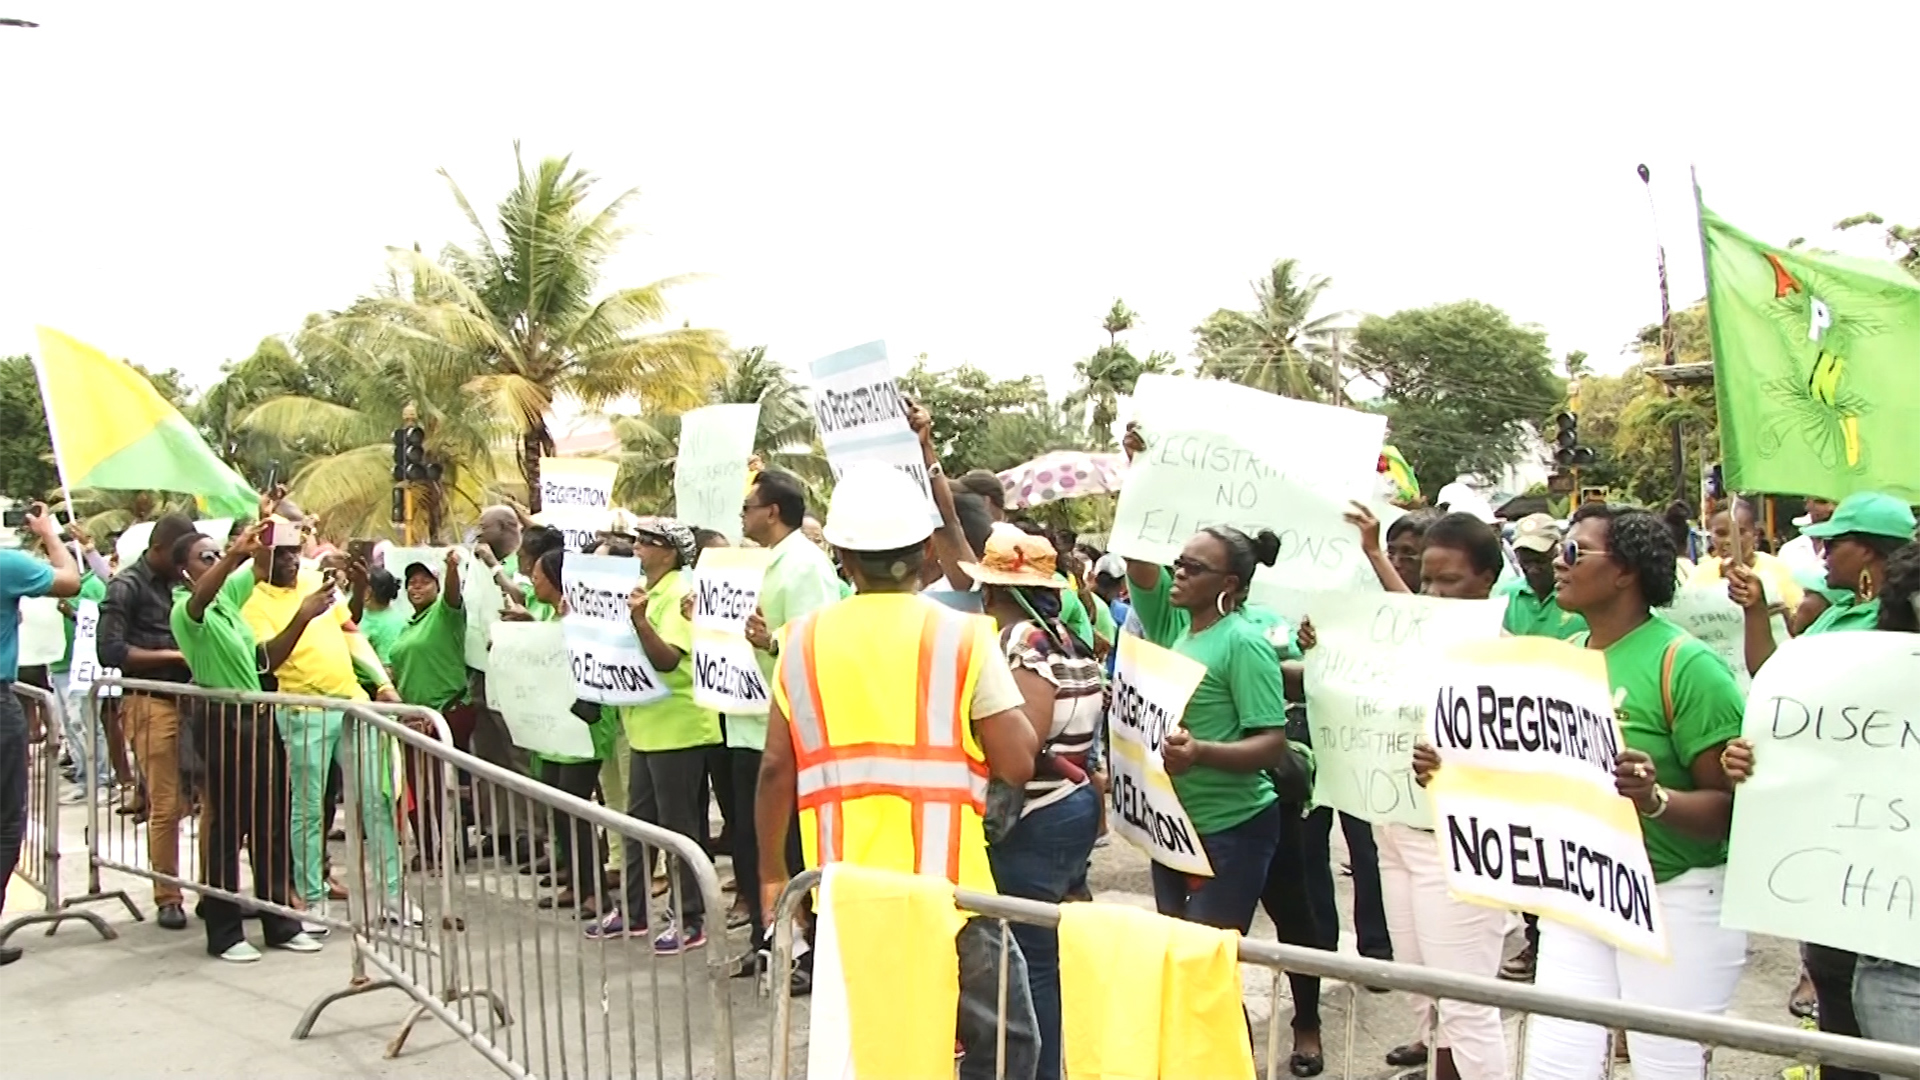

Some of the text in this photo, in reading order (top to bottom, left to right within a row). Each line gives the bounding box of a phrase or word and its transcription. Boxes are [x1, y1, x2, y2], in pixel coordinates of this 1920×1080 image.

[1216, 482, 1258, 509] NO
[698, 579, 719, 616] NO
[583, 652, 655, 692] ELECTION
[695, 652, 717, 690] NO
[1434, 685, 1618, 775] NO REGISTRATION
[1352, 767, 1418, 814] VOT
[1832, 793, 1911, 832] IS
[1446, 814, 1654, 933] NO ELECTION
